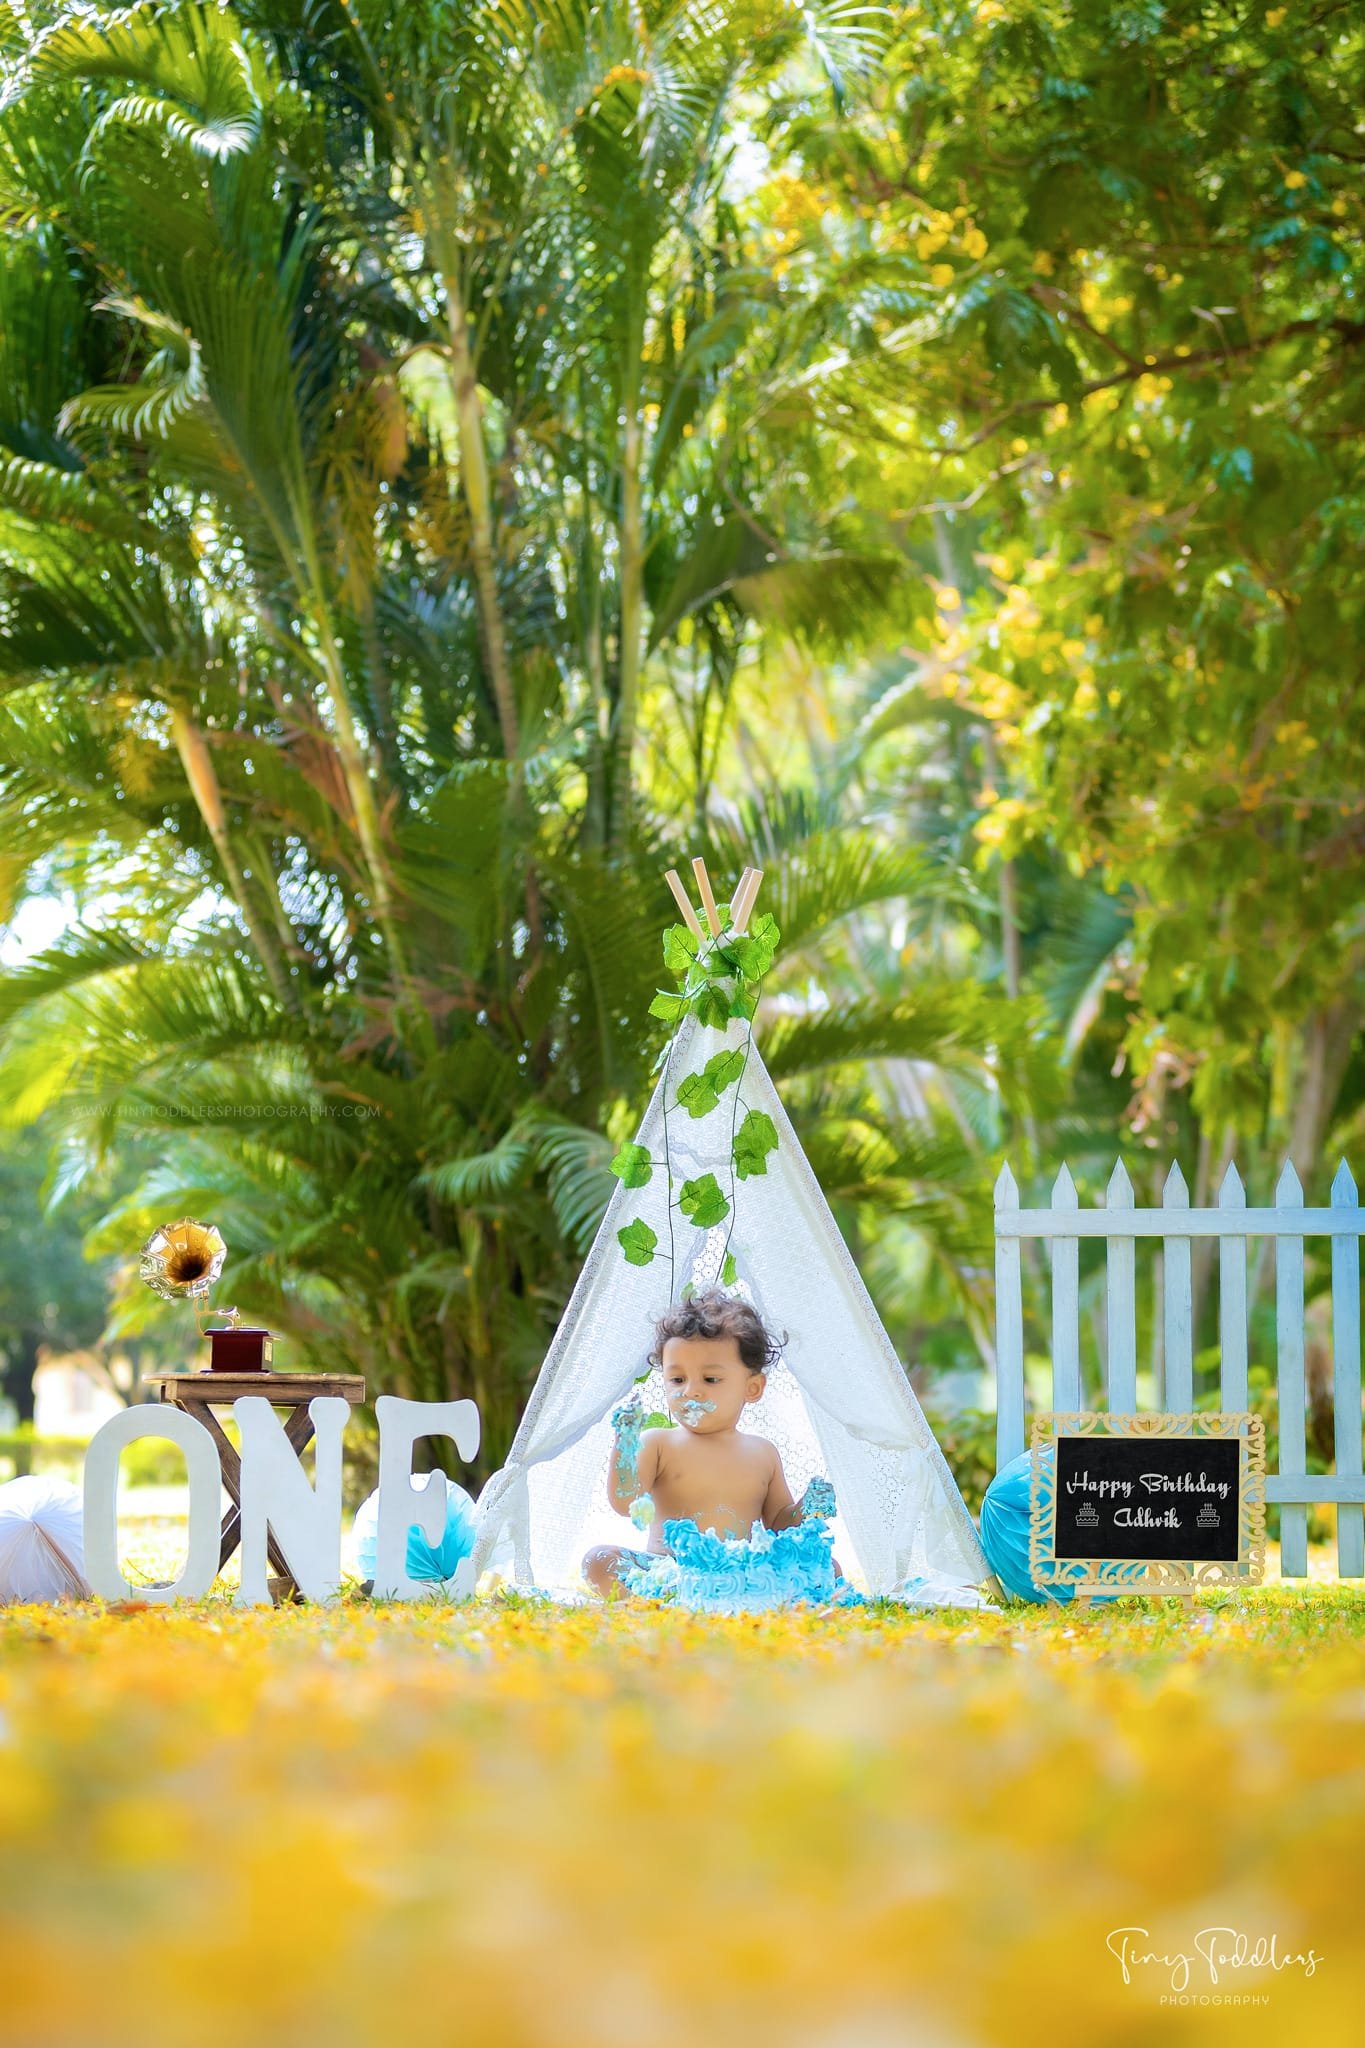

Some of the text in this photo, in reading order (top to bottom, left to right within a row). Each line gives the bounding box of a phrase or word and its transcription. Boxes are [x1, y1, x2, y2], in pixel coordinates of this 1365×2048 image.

[1066, 1471, 1232, 1499] Happy Birthday
[83, 1395, 480, 1606] ONE
[1113, 1507, 1182, 1528] Adhvik
